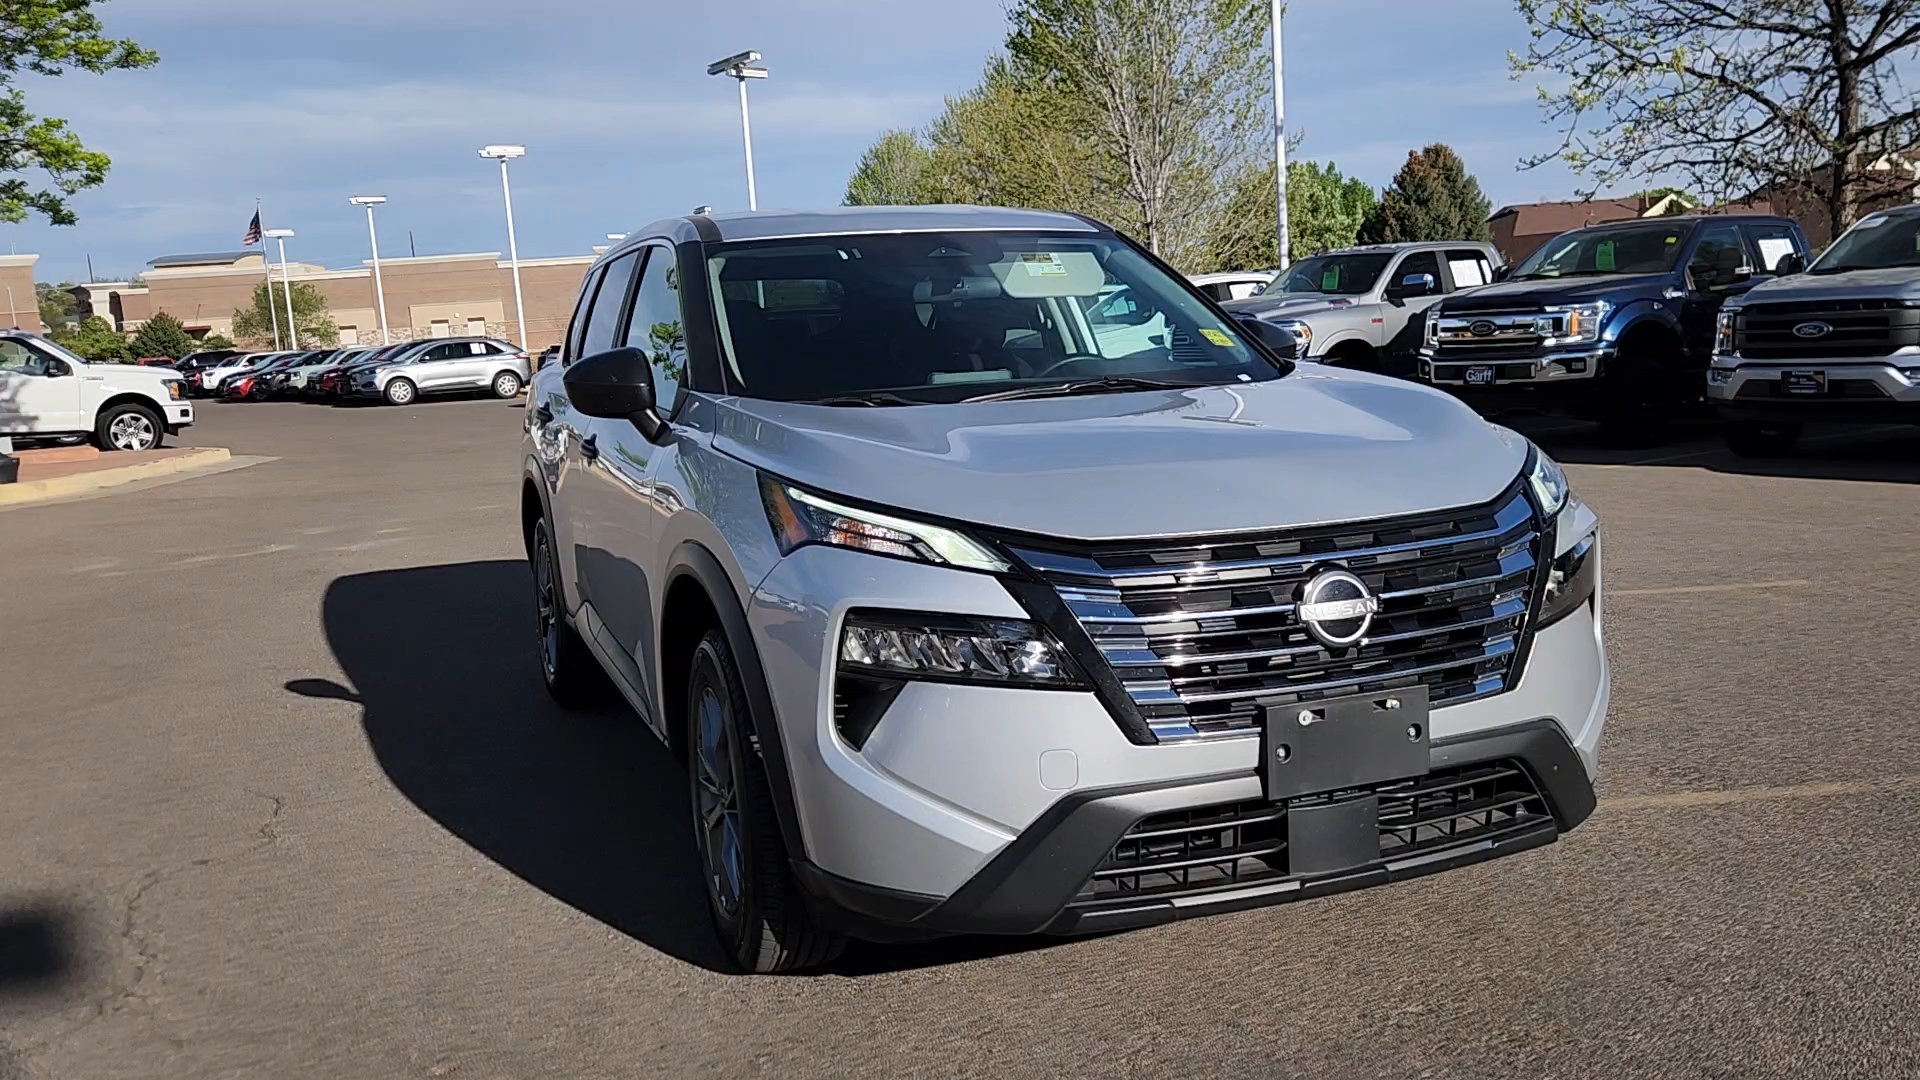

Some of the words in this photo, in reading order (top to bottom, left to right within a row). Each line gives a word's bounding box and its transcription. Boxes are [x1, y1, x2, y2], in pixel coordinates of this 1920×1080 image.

[1799, 326, 1820, 335] Ford
[1465, 369, 1492, 382] Garff
[1302, 599, 1378, 619] NISSAN
